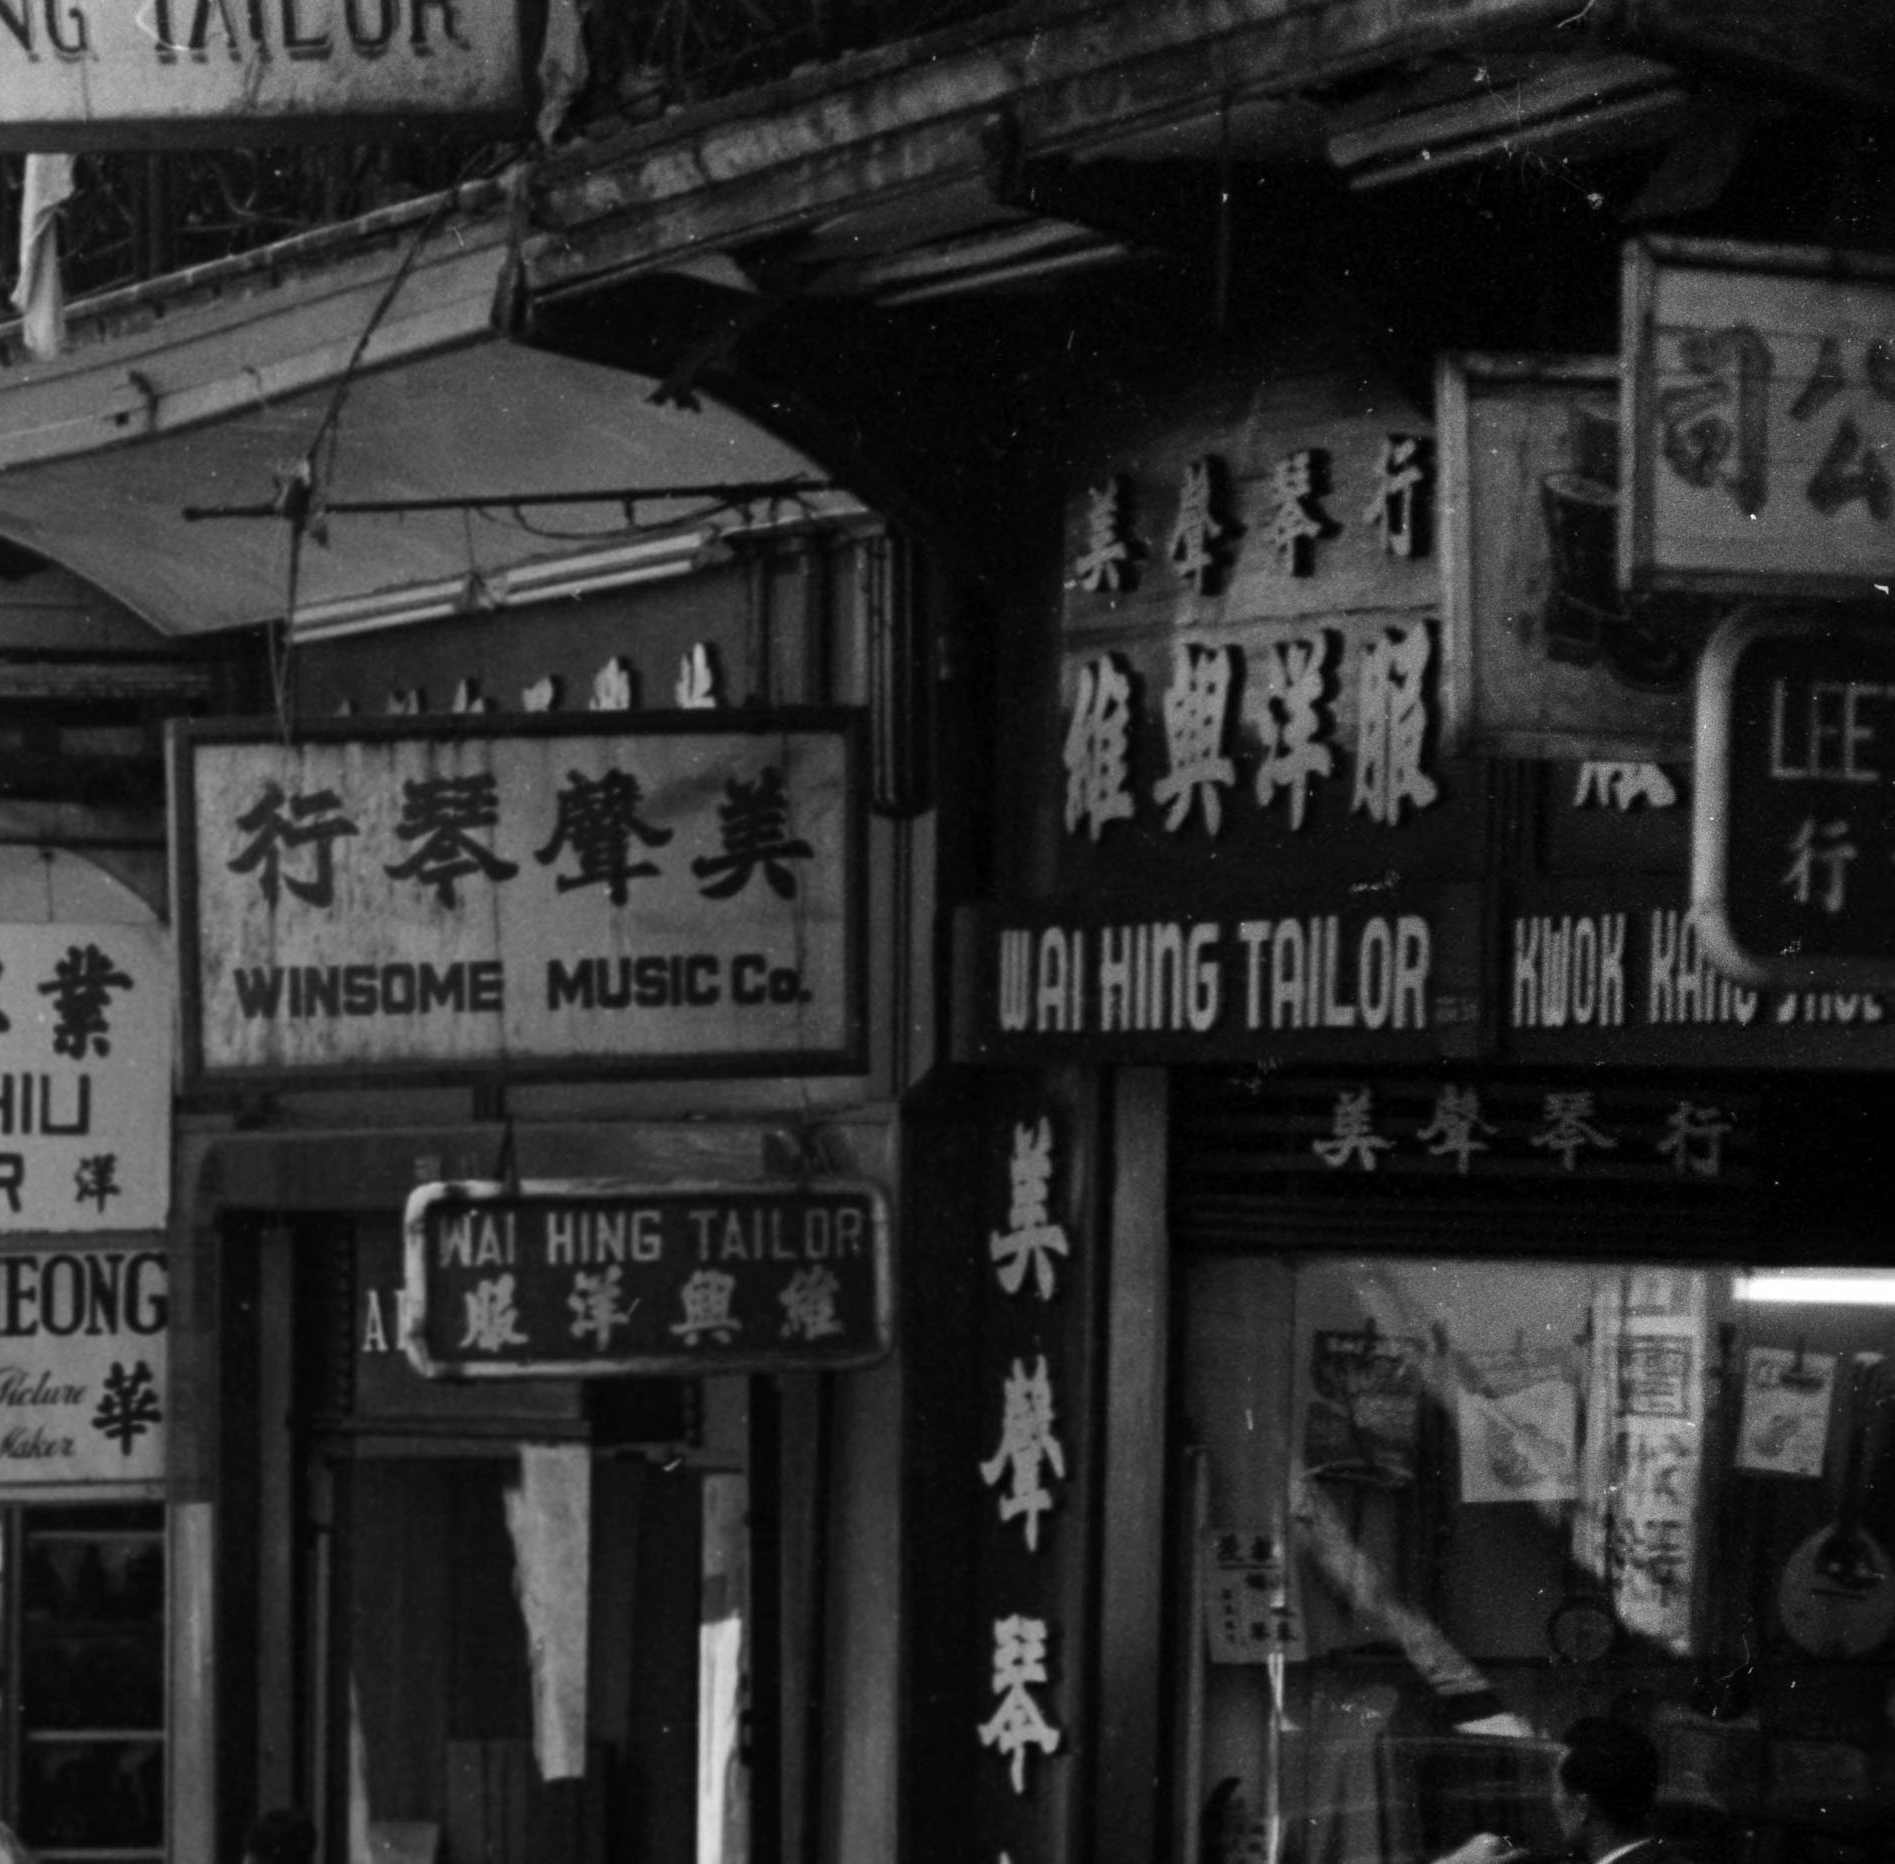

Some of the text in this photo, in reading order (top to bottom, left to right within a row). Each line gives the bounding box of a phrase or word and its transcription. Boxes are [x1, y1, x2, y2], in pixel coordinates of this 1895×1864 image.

[233, 960, 504, 1021] WINSOME
[546, 955, 720, 1013] MUSIC
[1000, 914, 1430, 1033] WAI HING TAILOR
[1513, 909, 1758, 1027] KWOK KA
[437, 1208, 864, 1270] WAI HING TAILOR
